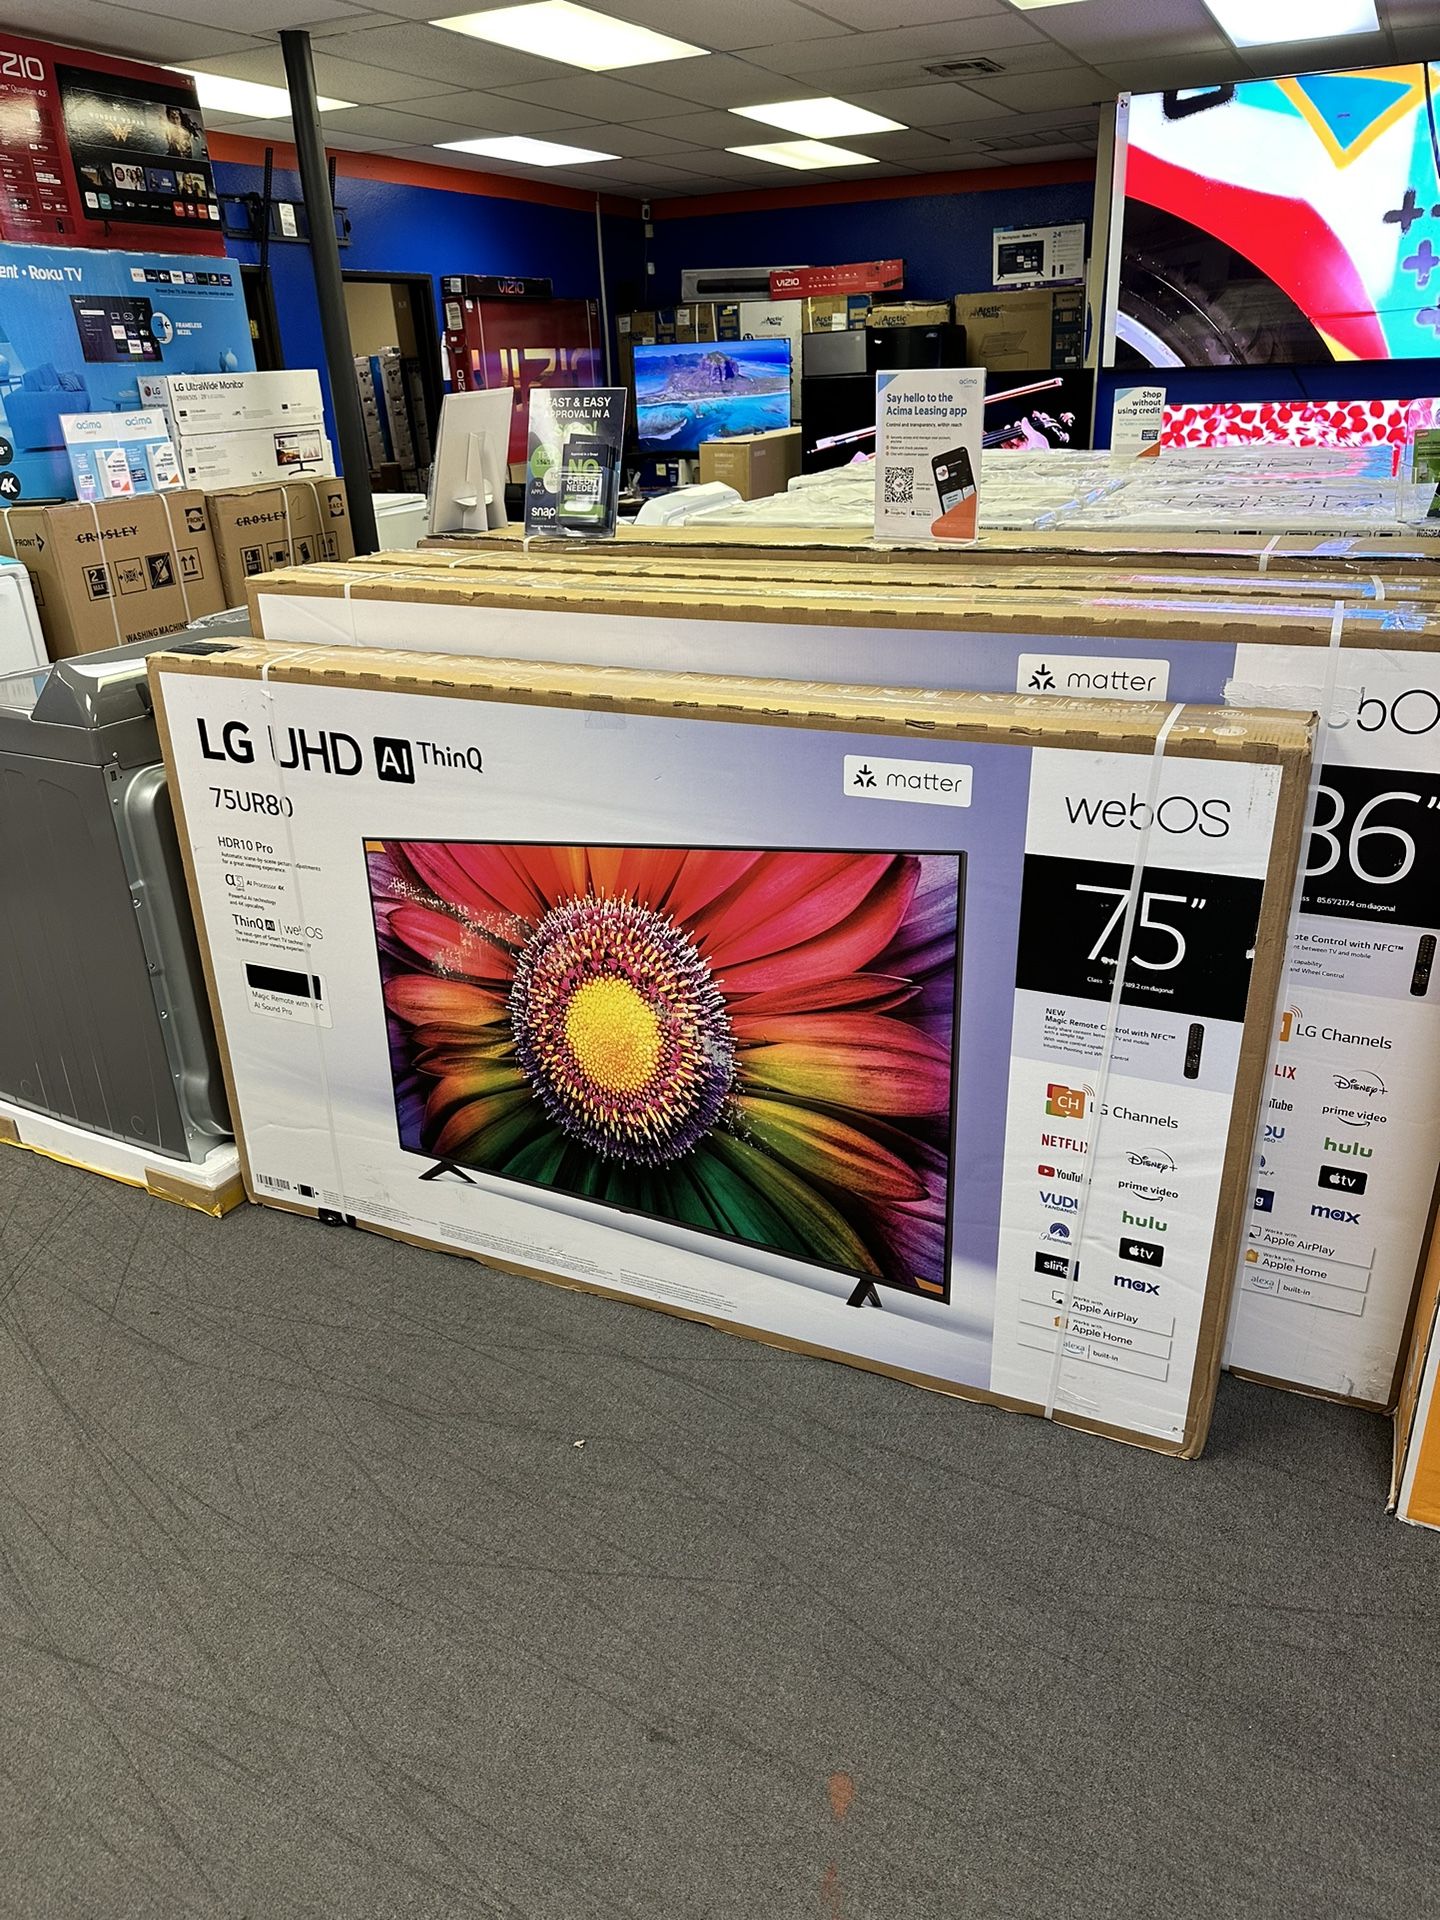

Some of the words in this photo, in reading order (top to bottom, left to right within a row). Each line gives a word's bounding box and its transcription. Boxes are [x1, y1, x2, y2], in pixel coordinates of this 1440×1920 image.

[0, 50, 44, 81] ZIO
[0, 264, 19, 280] ent
[29, 265, 64, 281] Roku
[64, 267, 82, 282] TV
[497, 279, 525, 295] VIZIO
[776, 277, 800, 288] VIZIO
[174, 383, 185, 392] LG
[220, 380, 245, 390] Monitor
[456, 369, 466, 392] ZIO
[959, 378, 978, 386] acima
[152, 386, 161, 396] LG
[886, 393, 903, 405] Say
[903, 393, 925, 403] hello
[926, 394, 937, 403] to
[938, 392, 954, 403] the
[1142, 391, 1162, 399] Shop
[573, 397, 580, 408] &
[583, 397, 612, 408] EASY
[592, 409, 602, 419] IN
[603, 409, 611, 419] A
[886, 405, 913, 416] Acima
[914, 405, 948, 418] Leasing
[949, 407, 968, 418] app
[1117, 407, 1138, 415] using
[76, 420, 102, 430] acima
[125, 416, 153, 427] acima
[1, 479, 18, 493] 4K
[566, 484, 600, 493] NEEDED
[328, 502, 344, 510] BACK
[531, 506, 557, 519] snap
[186, 516, 205, 525] FRONT
[235, 510, 288, 527] CROSLEY
[15, 537, 36, 548] FRONT
[76, 525, 138, 544] CROSLEY
[126, 627, 159, 643] WASHING
[159, 621, 190, 636] MACHINE
[1067, 670, 1156, 692] matter
[1328, 686, 1440, 735] bO
[197, 718, 255, 764] LG
[267, 724, 363, 776] UHD
[379, 743, 411, 777] AI
[416, 740, 484, 773] ThinQ
[886, 769, 963, 795] matter
[209, 786, 294, 818] 75UR80
[1065, 792, 1231, 838] webOS
[217, 836, 254, 851] HDR10
[255, 841, 274, 854] Pro
[1367, 903, 1396, 913] diagonal
[232, 914, 264, 931] ThinQ
[1294, 934, 1309, 942] ote
[1311, 934, 1347, 947] Control
[1349, 939, 1371, 950] with
[1350, 951, 1371, 959] mobile
[1087, 976, 1103, 984] Class
[1322, 970, 1345, 979] Control
[252, 990, 270, 1001] Magic
[271, 993, 295, 1005] Remote
[261, 1003, 281, 1013] Sound
[282, 1007, 293, 1015] Pro
[1046, 1008, 1066, 1017] NEW
[1045, 1015, 1068, 1025] Magic
[1069, 1019, 1099, 1030] Remote
[1100, 1023, 1130, 1035] Ctrol
[1131, 1028, 1149, 1038] with
[1296, 1023, 1317, 1038] LG
[1321, 1027, 1392, 1050] Channels
[1274, 1064, 1297, 1080] LIX
[1333, 1073, 1388, 1097] Disney+
[1057, 1095, 1079, 1110] CH
[1269, 1098, 1294, 1112] Tube
[1112, 1106, 1179, 1129] Channels
[1322, 1105, 1355, 1118] prime
[1356, 1109, 1387, 1123] video
[1323, 1136, 1373, 1158] hulu
[1125, 1150, 1178, 1173] Disney+
[1118, 1179, 1149, 1193] prime
[1150, 1185, 1179, 1199] video
[1122, 1210, 1167, 1232] hulu
[1310, 1203, 1361, 1225] max
[1263, 1234, 1295, 1247] Apple
[1297, 1239, 1335, 1257] AirPlay
[1044, 1261, 1070, 1275] sling
[1262, 1258, 1293, 1272] Apple
[1295, 1264, 1328, 1279] Home
[1114, 1275, 1161, 1296] max
[1251, 1275, 1275, 1287] alexa
[1283, 1284, 1311, 1296] built-in
[1072, 1300, 1101, 1314] Apple
[1103, 1308, 1139, 1324] AirPlay
[1072, 1323, 1101, 1337] Apple
[1103, 1330, 1133, 1346] Home
[1063, 1340, 1085, 1352] alexa
[1092, 1349, 1119, 1362] built-in
